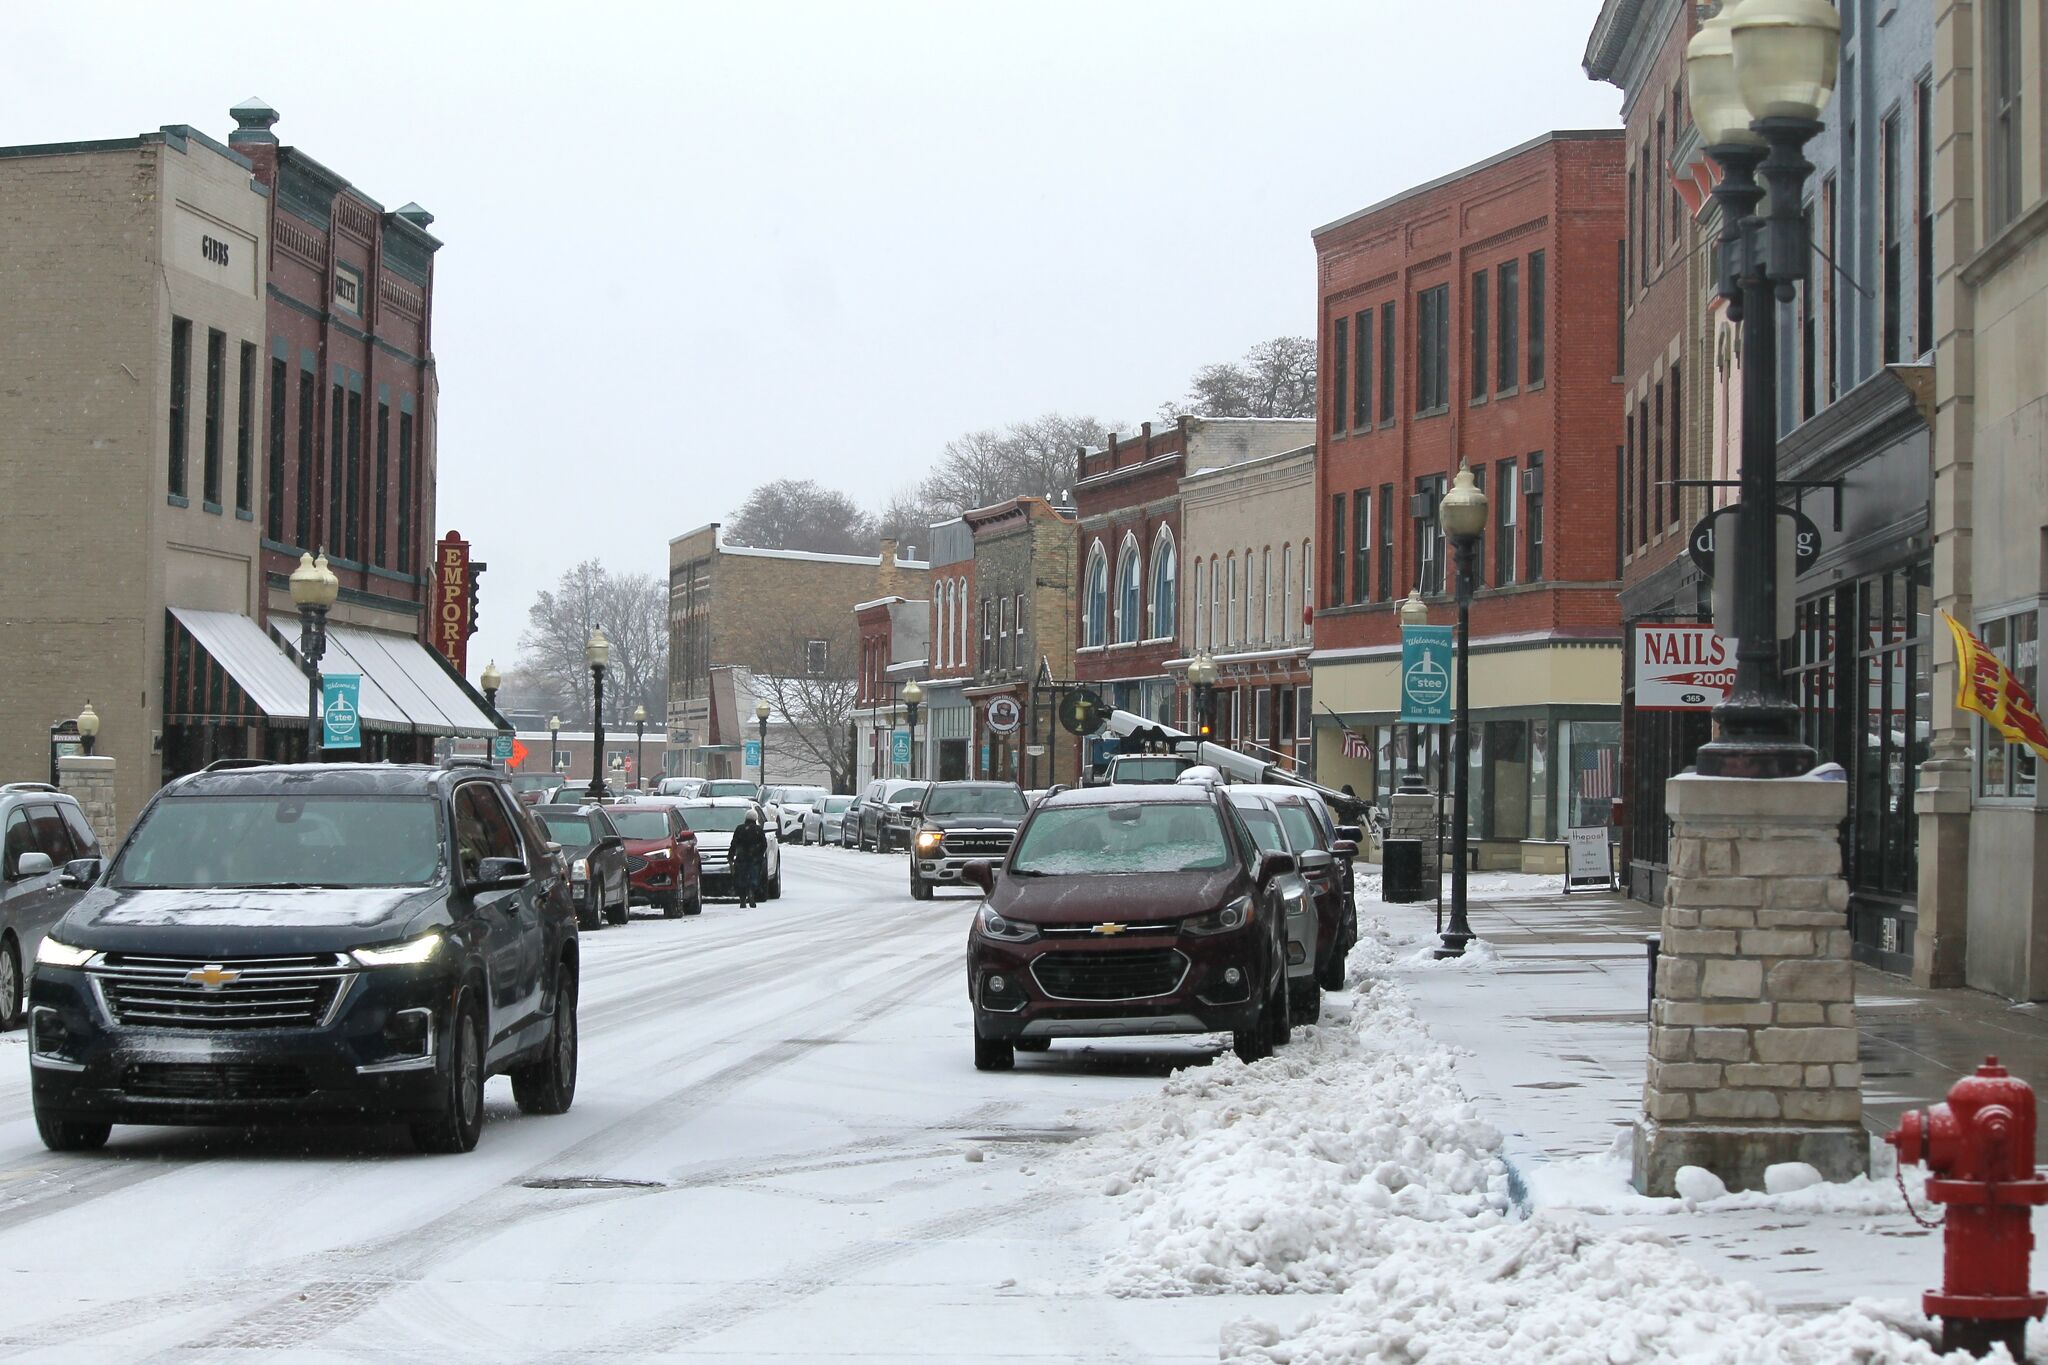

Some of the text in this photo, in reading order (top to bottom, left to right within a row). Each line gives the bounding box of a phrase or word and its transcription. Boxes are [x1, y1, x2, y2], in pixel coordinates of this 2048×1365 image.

[202, 234, 229, 266] GIBBS
[1406, 636, 1440, 647] Welcome
[1644, 633, 1726, 666] NAILS
[1417, 678, 1442, 688] stee
[1692, 673, 1736, 685] 2000
[1686, 695, 1701, 703] 365
